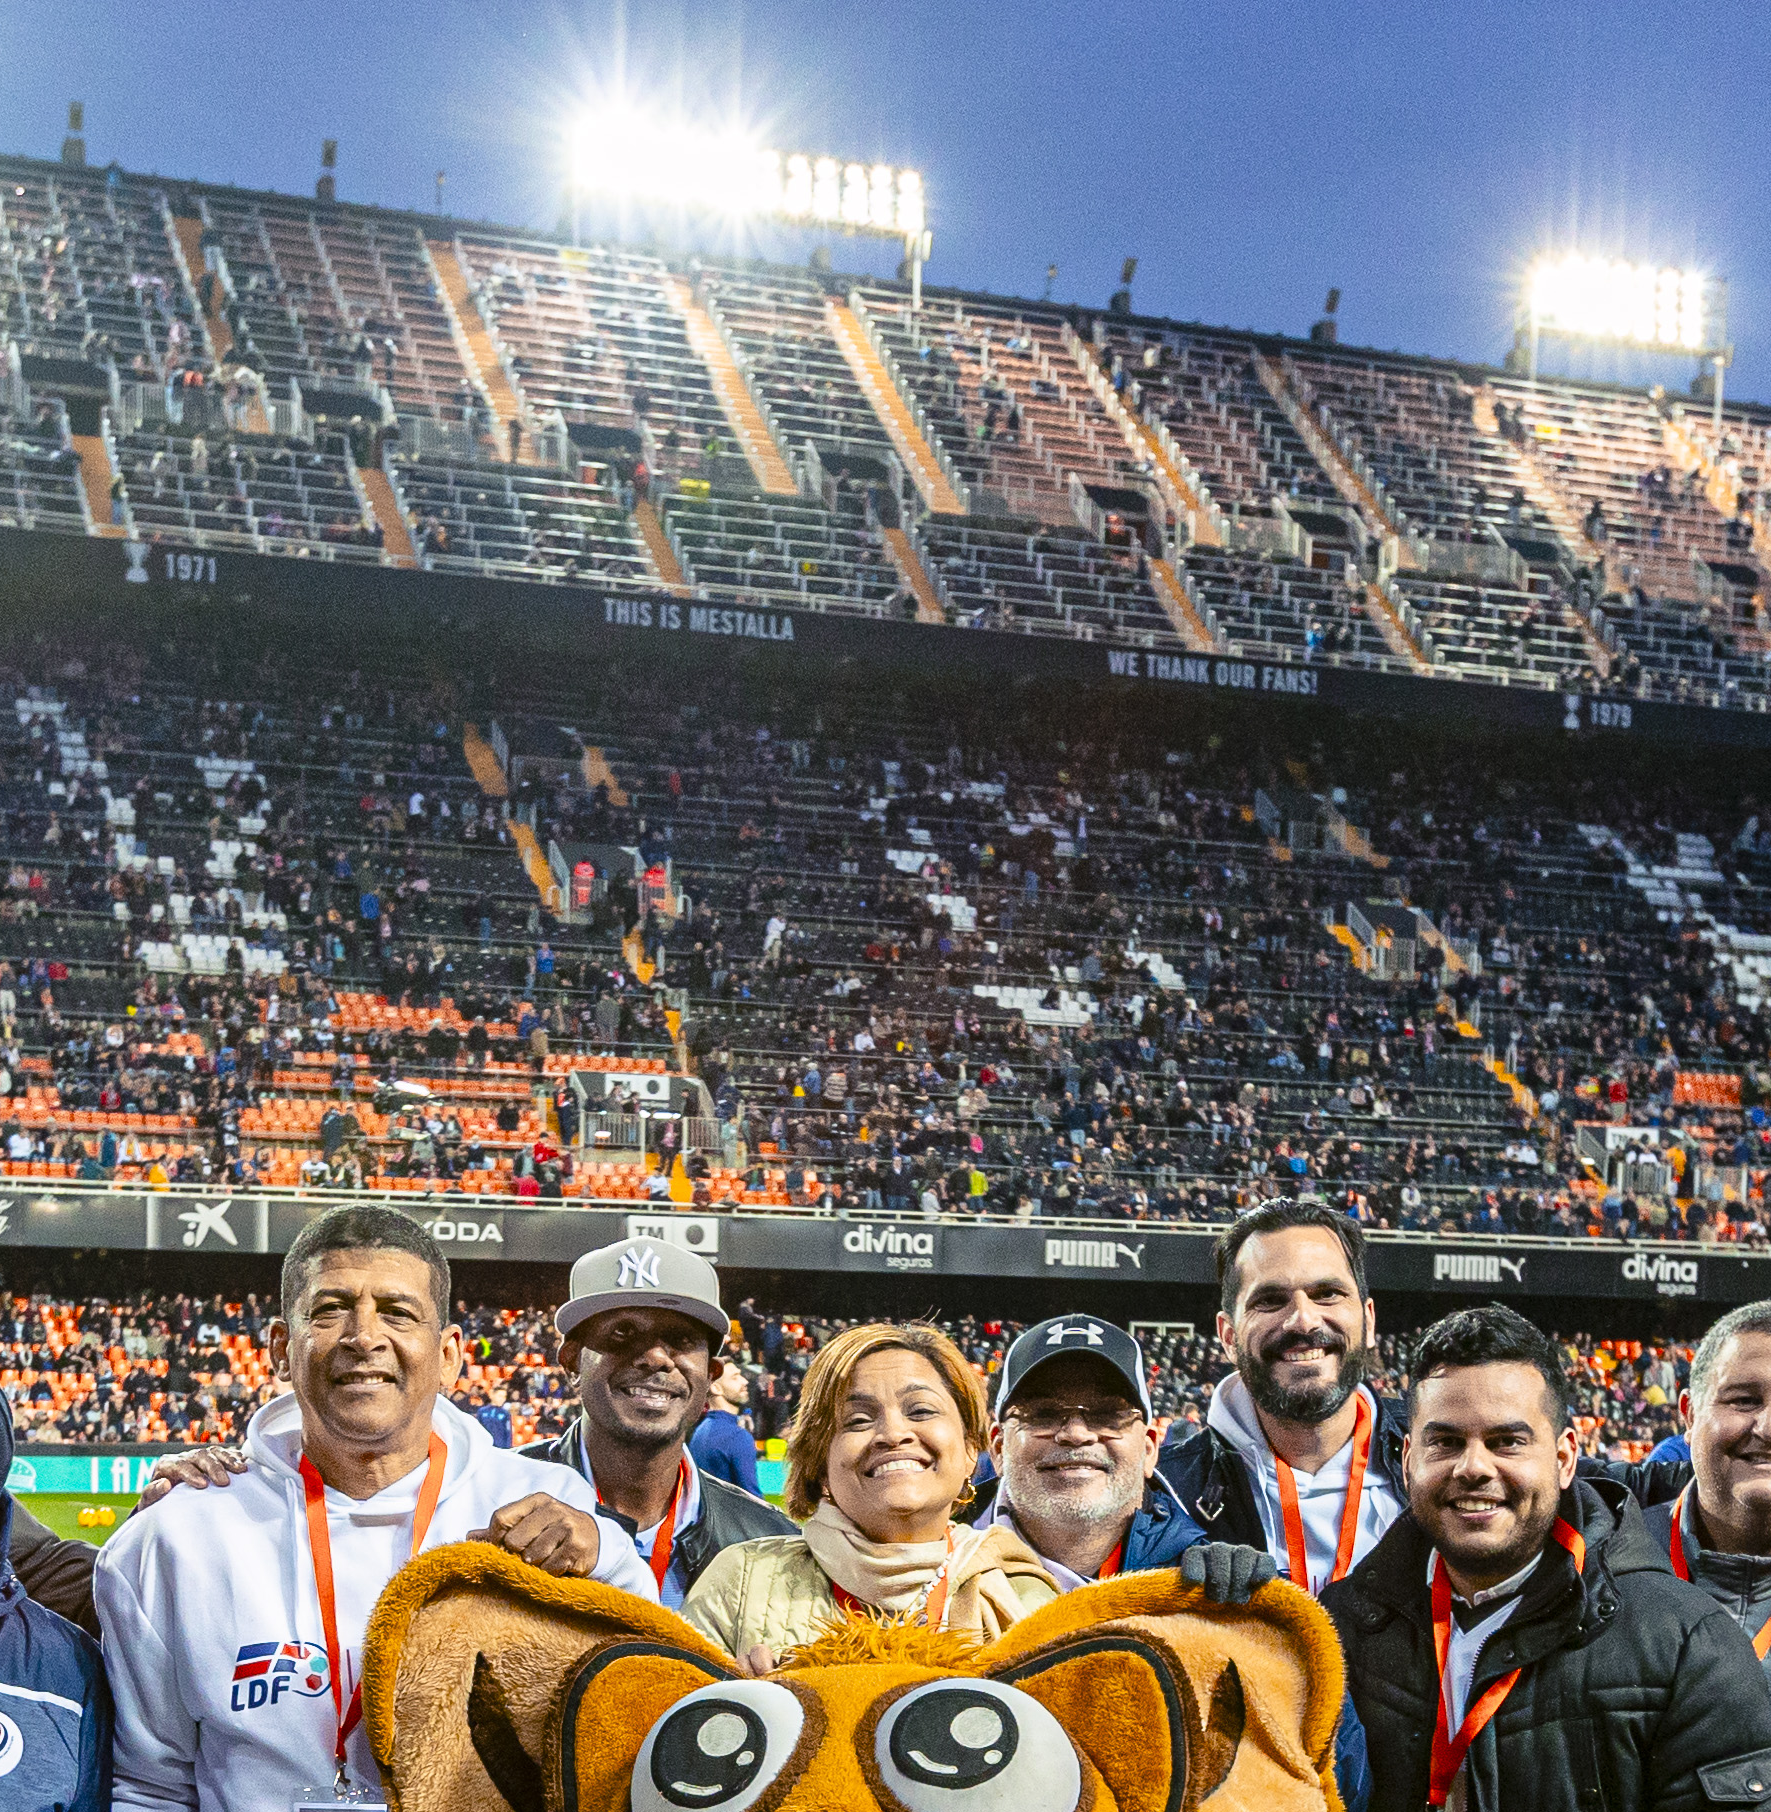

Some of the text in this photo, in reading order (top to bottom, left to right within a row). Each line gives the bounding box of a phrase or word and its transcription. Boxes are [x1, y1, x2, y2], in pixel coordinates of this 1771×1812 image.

[166, 553, 218, 583] 1971
[604, 600, 794, 641] THIS IS MESTALLA
[1109, 650, 1318, 695] WE THANK OUR FANS!
[423, 1221, 504, 1242] ODA
[844, 1224, 933, 1255] divina
[617, 1246, 661, 1288] NY
[887, 1255, 933, 1269] seguros
[1045, 1239, 1117, 1268] PUMA
[1435, 1254, 1503, 1282] PUMA
[1622, 1253, 1698, 1283] divina
[230, 1676, 291, 1712] LDF
